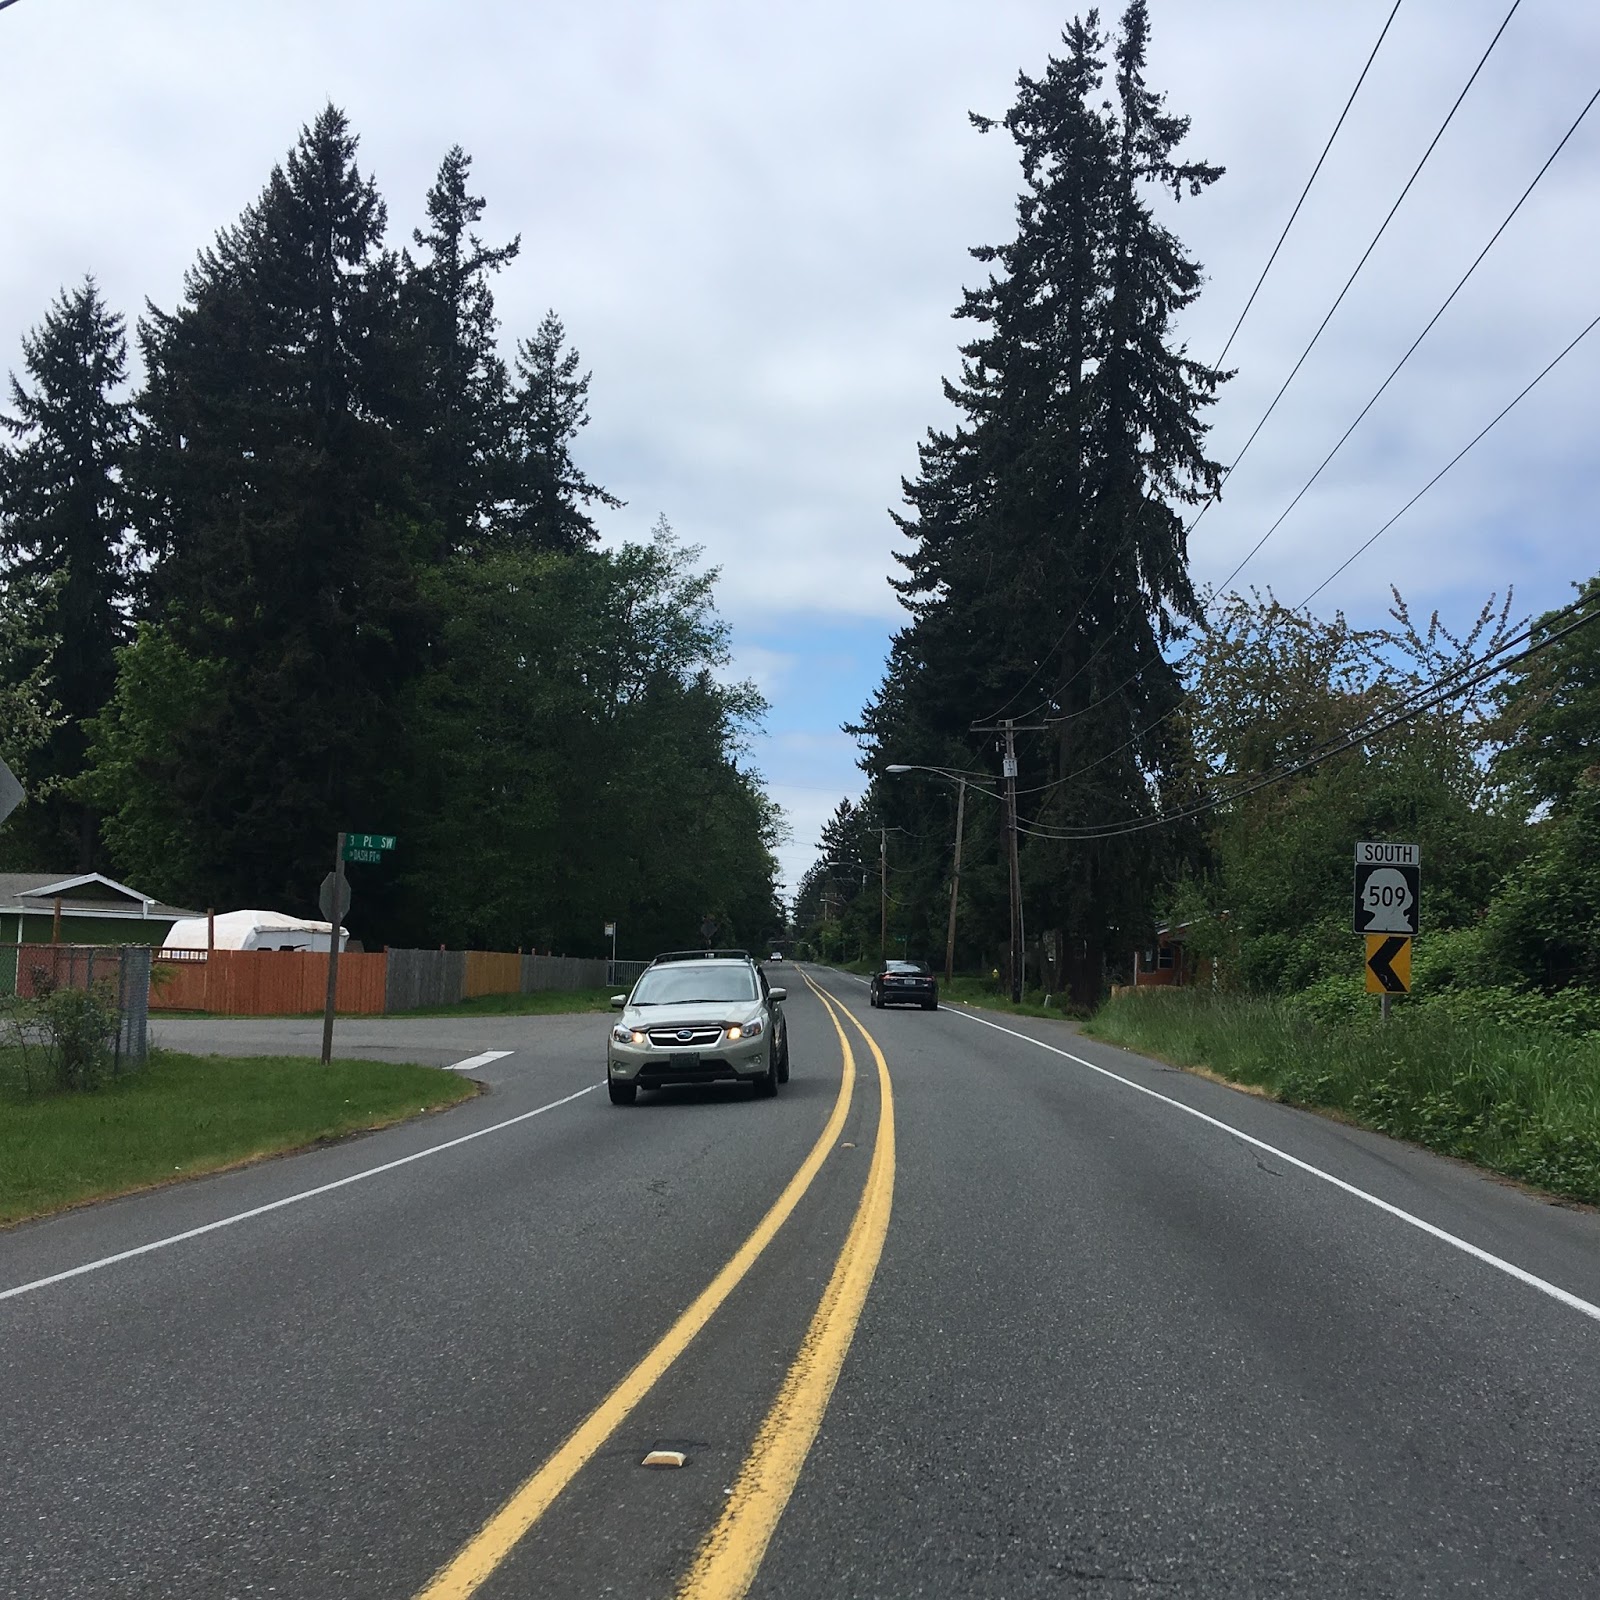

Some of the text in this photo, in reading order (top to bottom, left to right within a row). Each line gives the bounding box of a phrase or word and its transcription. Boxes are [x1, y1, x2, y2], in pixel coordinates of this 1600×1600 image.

[363, 835, 373, 848] PL
[380, 837, 394, 849] SW
[1364, 844, 1412, 863] SOUTH
[1369, 885, 1406, 907] 509
